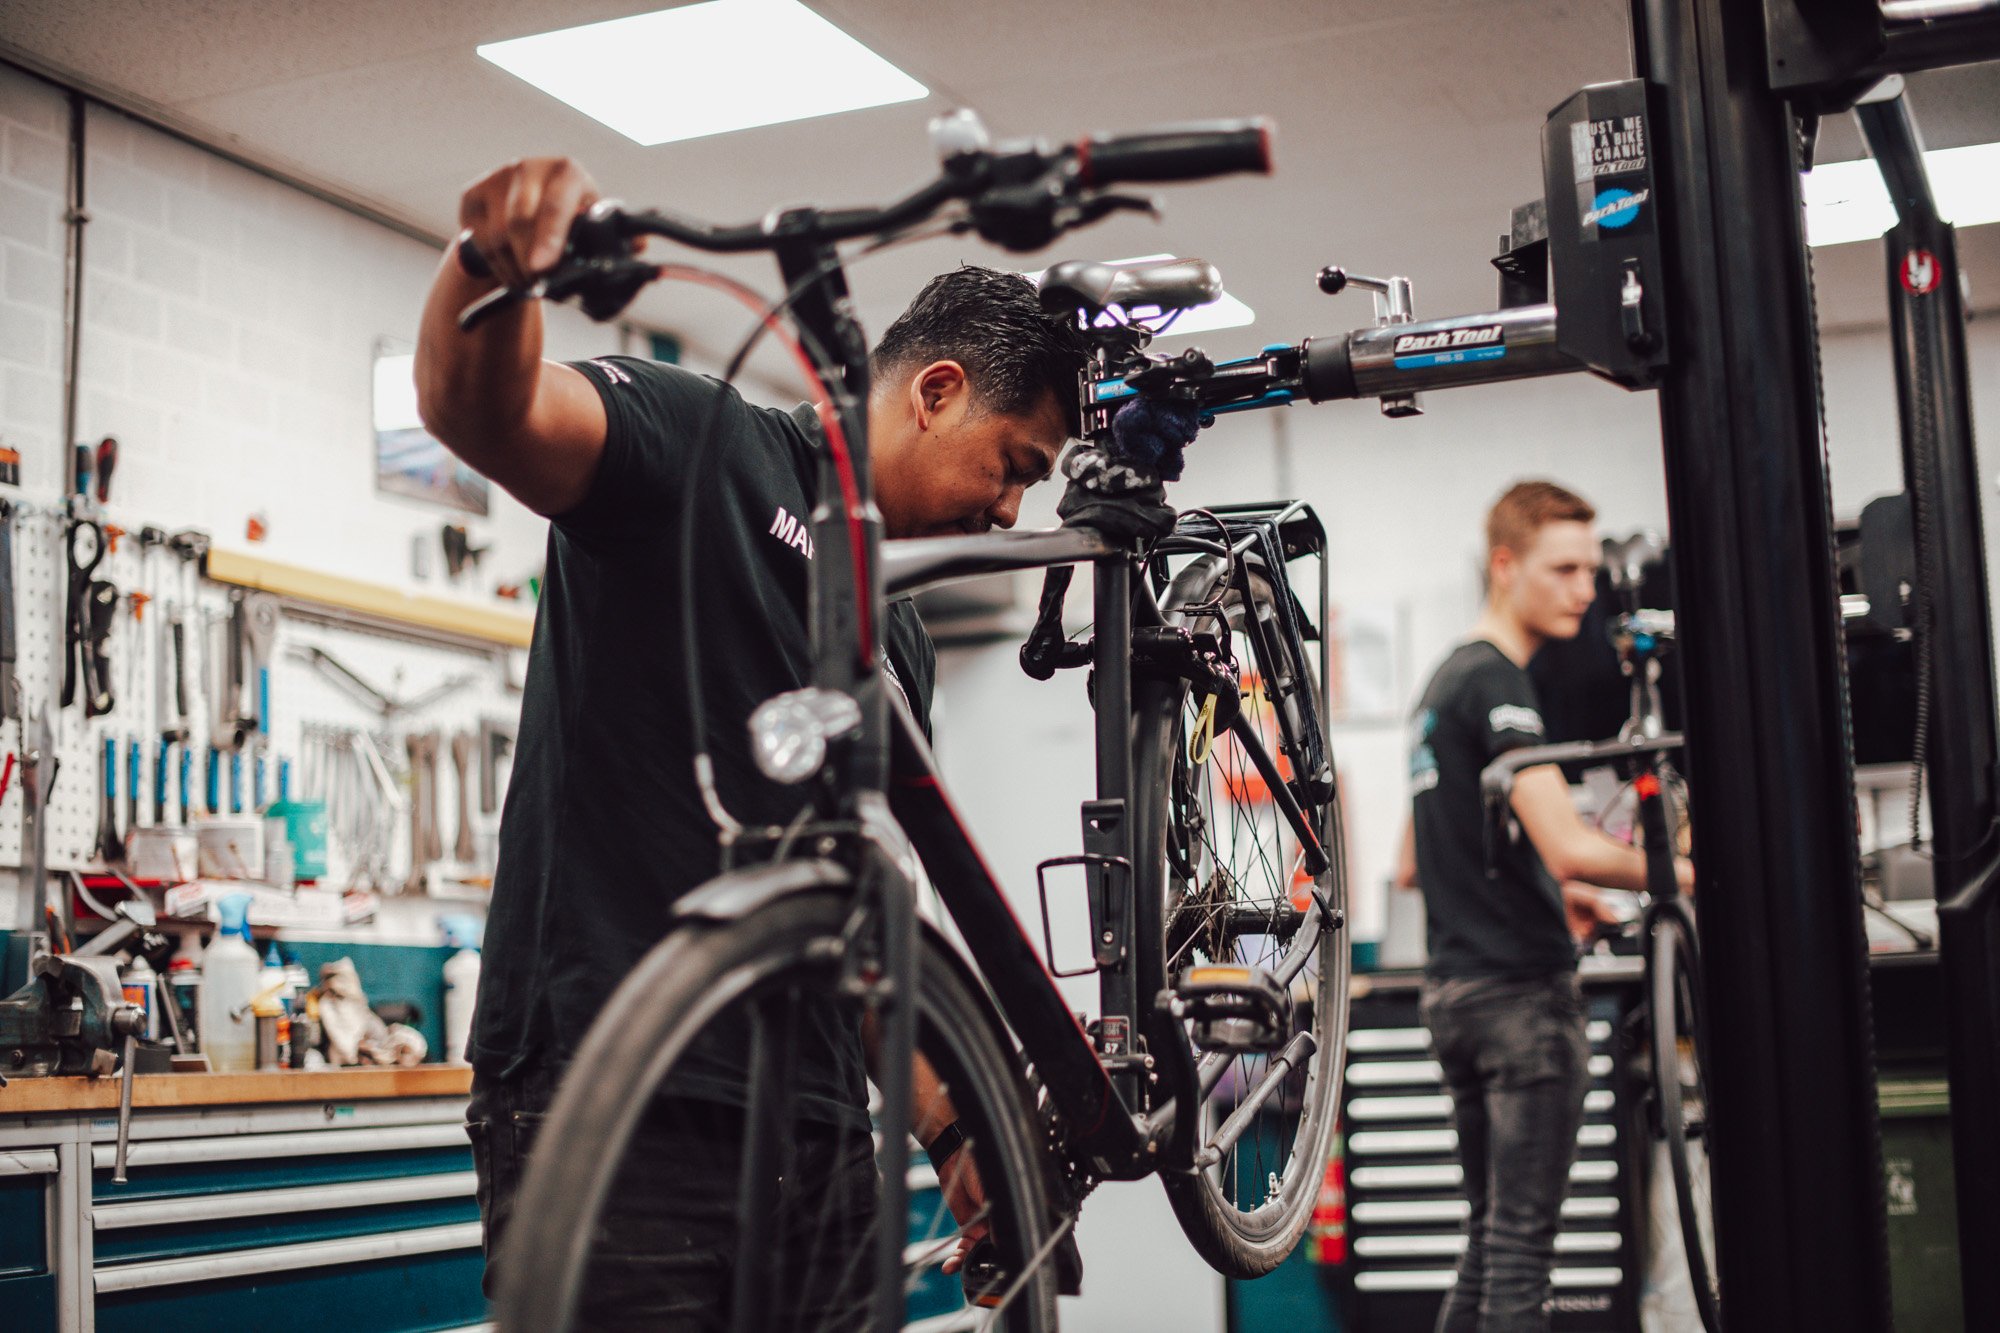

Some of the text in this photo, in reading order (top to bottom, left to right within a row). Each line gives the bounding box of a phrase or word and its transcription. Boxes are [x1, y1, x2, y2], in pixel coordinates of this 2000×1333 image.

[1623, 116, 1642, 130] ME
[1600, 133, 1609, 147] A
[1613, 129, 1643, 146] BIKE
[1577, 142, 1645, 164] MECHANIC
[1105, 1042, 1119, 1054] 57
